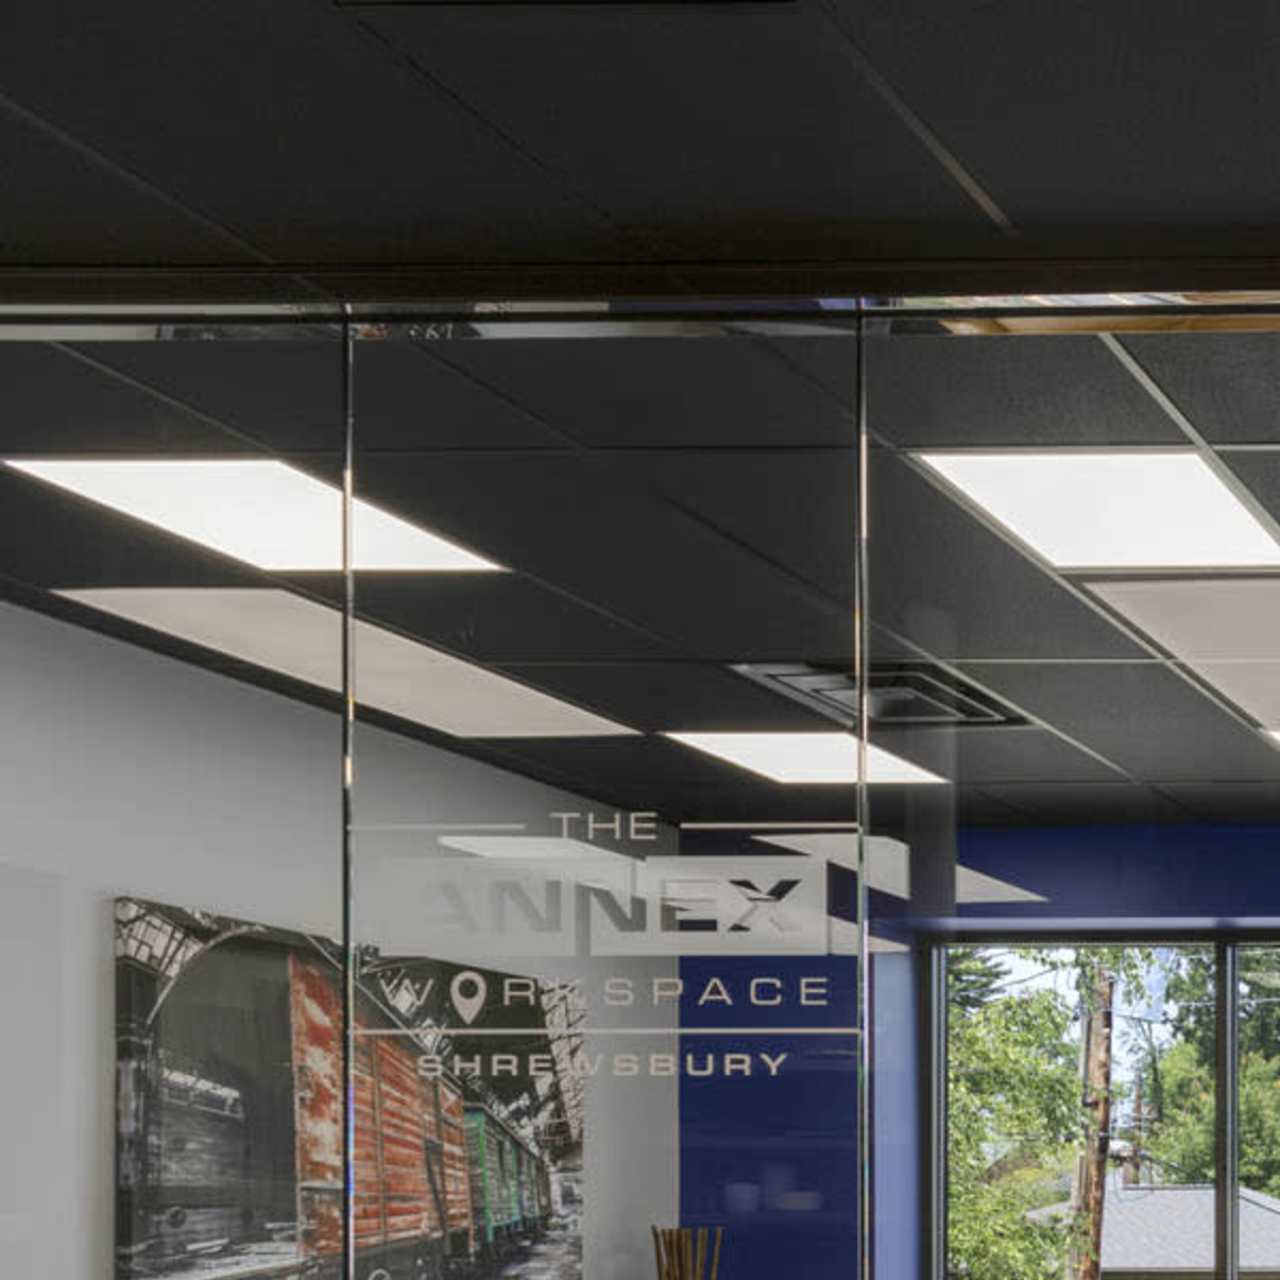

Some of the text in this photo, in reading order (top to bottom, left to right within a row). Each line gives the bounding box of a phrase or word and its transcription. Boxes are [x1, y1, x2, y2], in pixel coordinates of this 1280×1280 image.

[549, 812, 659, 841] THE
[425, 877, 803, 933] ANNEX
[418, 1053, 789, 1077] SHREWSBURY
